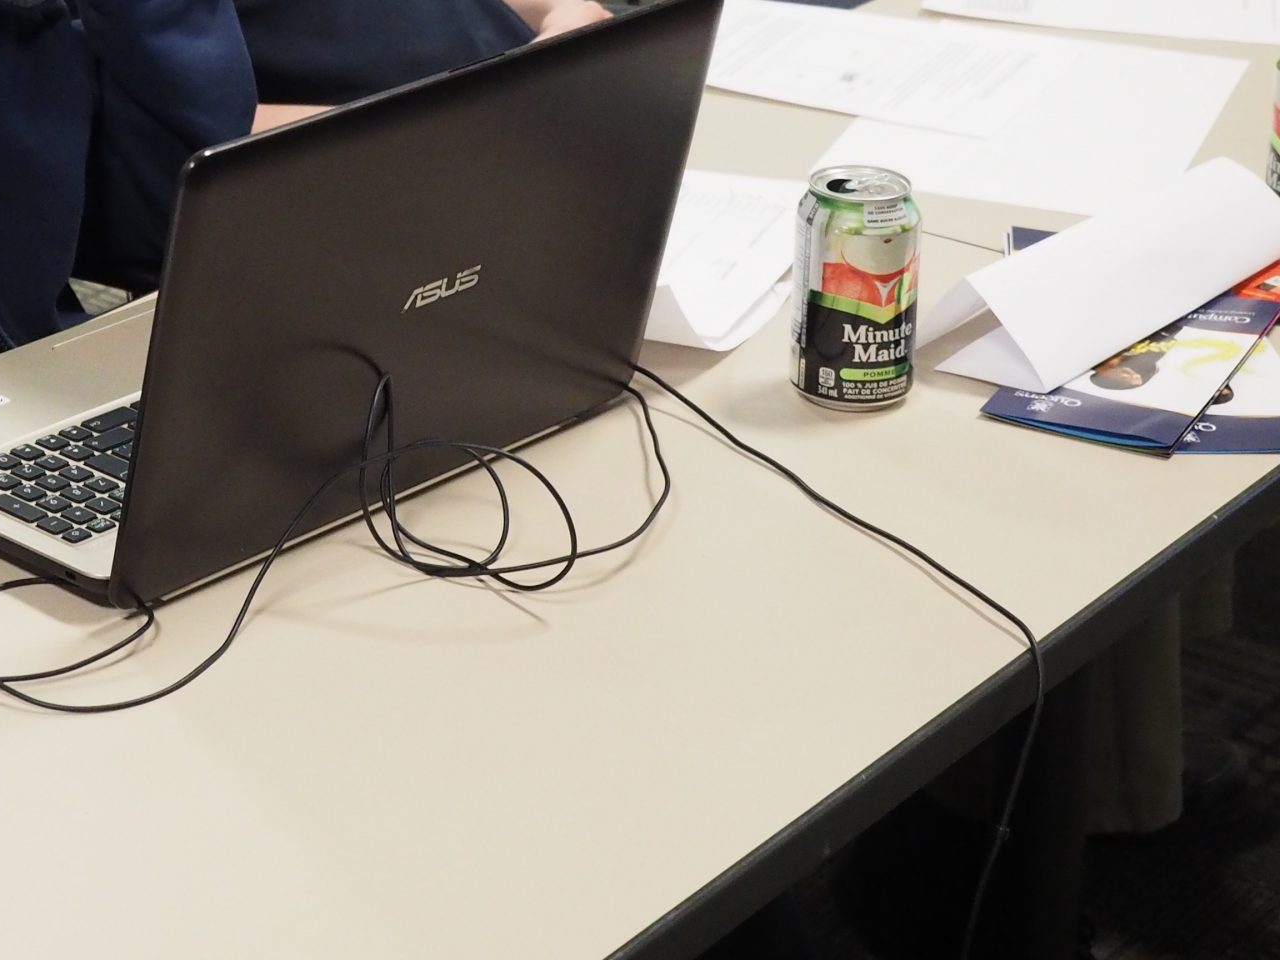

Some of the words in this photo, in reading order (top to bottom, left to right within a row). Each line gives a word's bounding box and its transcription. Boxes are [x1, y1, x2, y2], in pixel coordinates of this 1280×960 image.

[401, 264, 482, 314] ASUS
[841, 321, 913, 344] Minute
[852, 338, 906, 363] Maid
